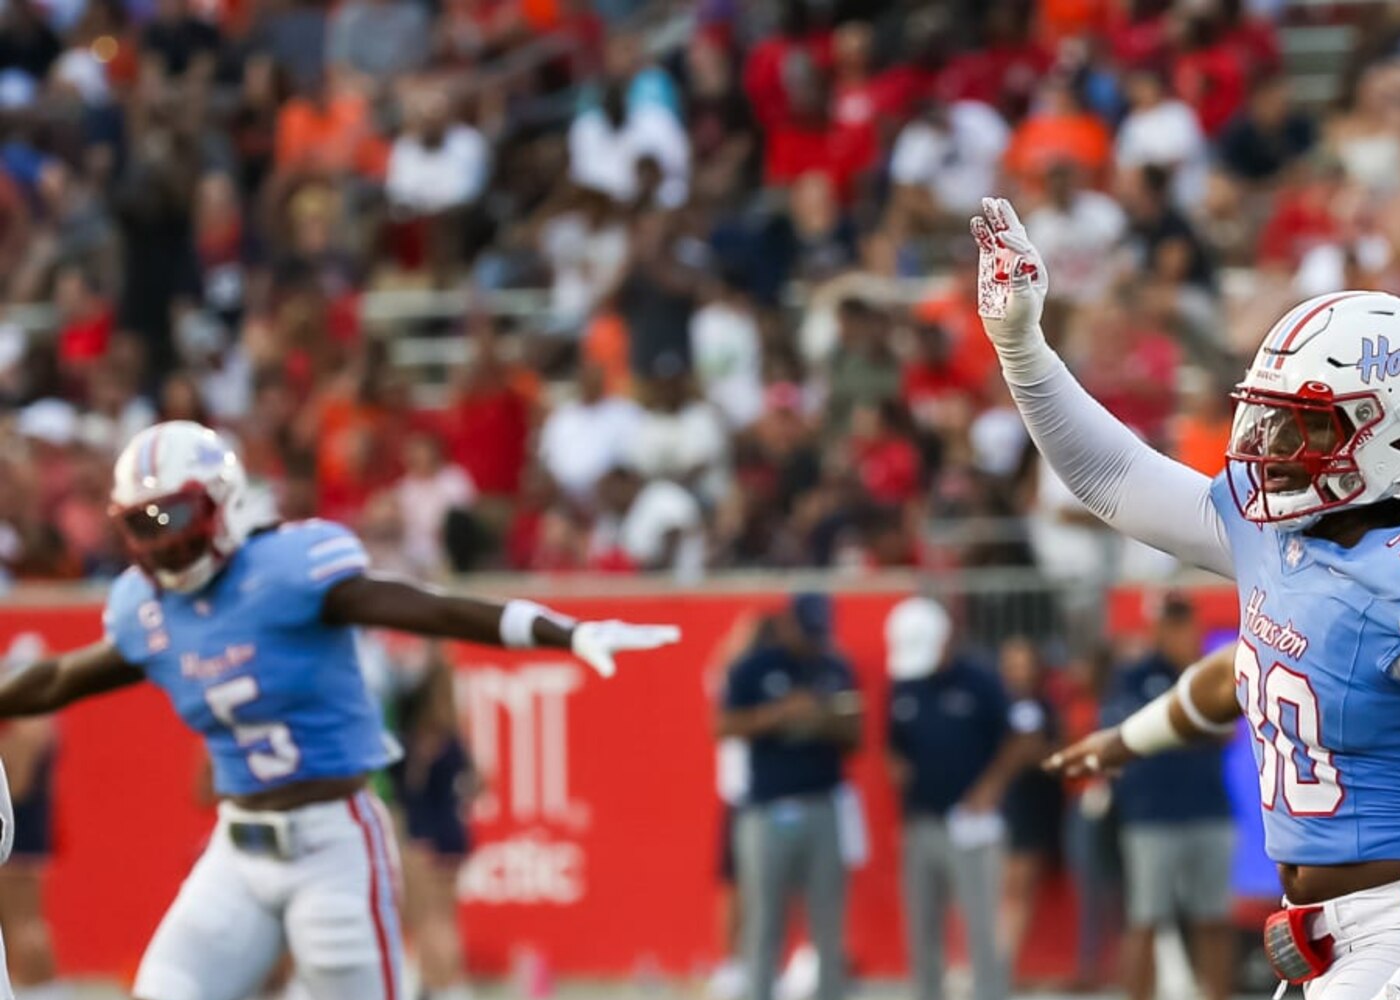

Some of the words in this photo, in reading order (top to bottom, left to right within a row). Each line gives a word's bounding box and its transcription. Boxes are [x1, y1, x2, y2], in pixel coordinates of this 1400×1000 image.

[1243, 586, 1309, 662] Houston
[204, 674, 302, 784] 5
[1234, 635, 1346, 817] 30
